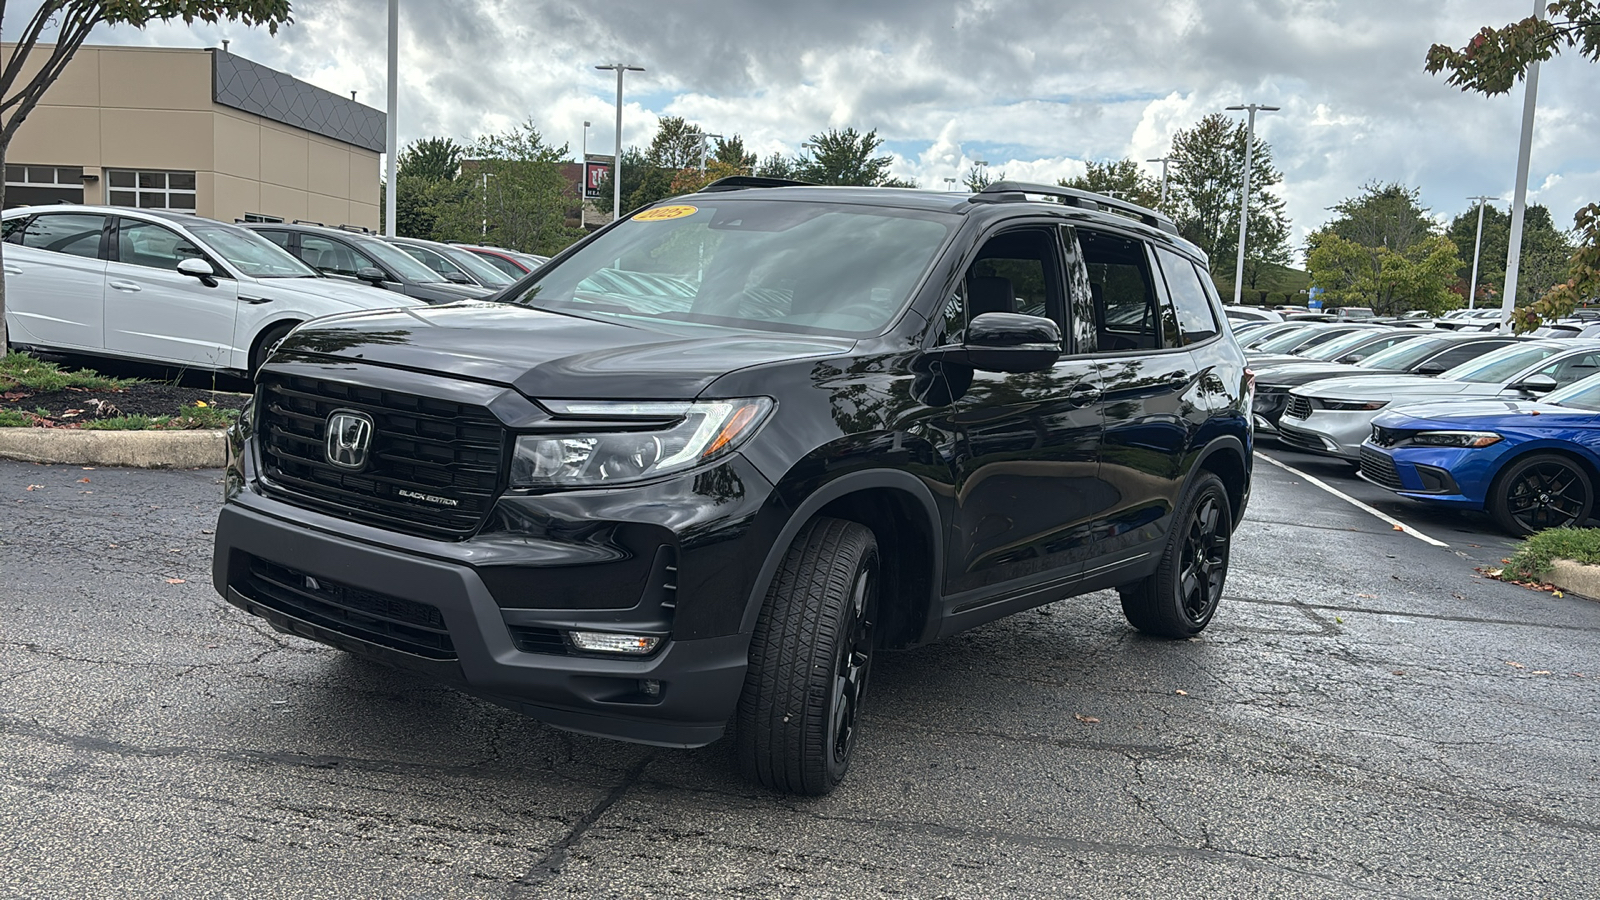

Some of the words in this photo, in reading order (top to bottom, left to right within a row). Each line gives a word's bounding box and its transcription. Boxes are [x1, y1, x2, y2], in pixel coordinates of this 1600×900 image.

[637, 207, 691, 219] 2025
[398, 489, 426, 501] BLACK
[426, 495, 459, 506] EDITION
